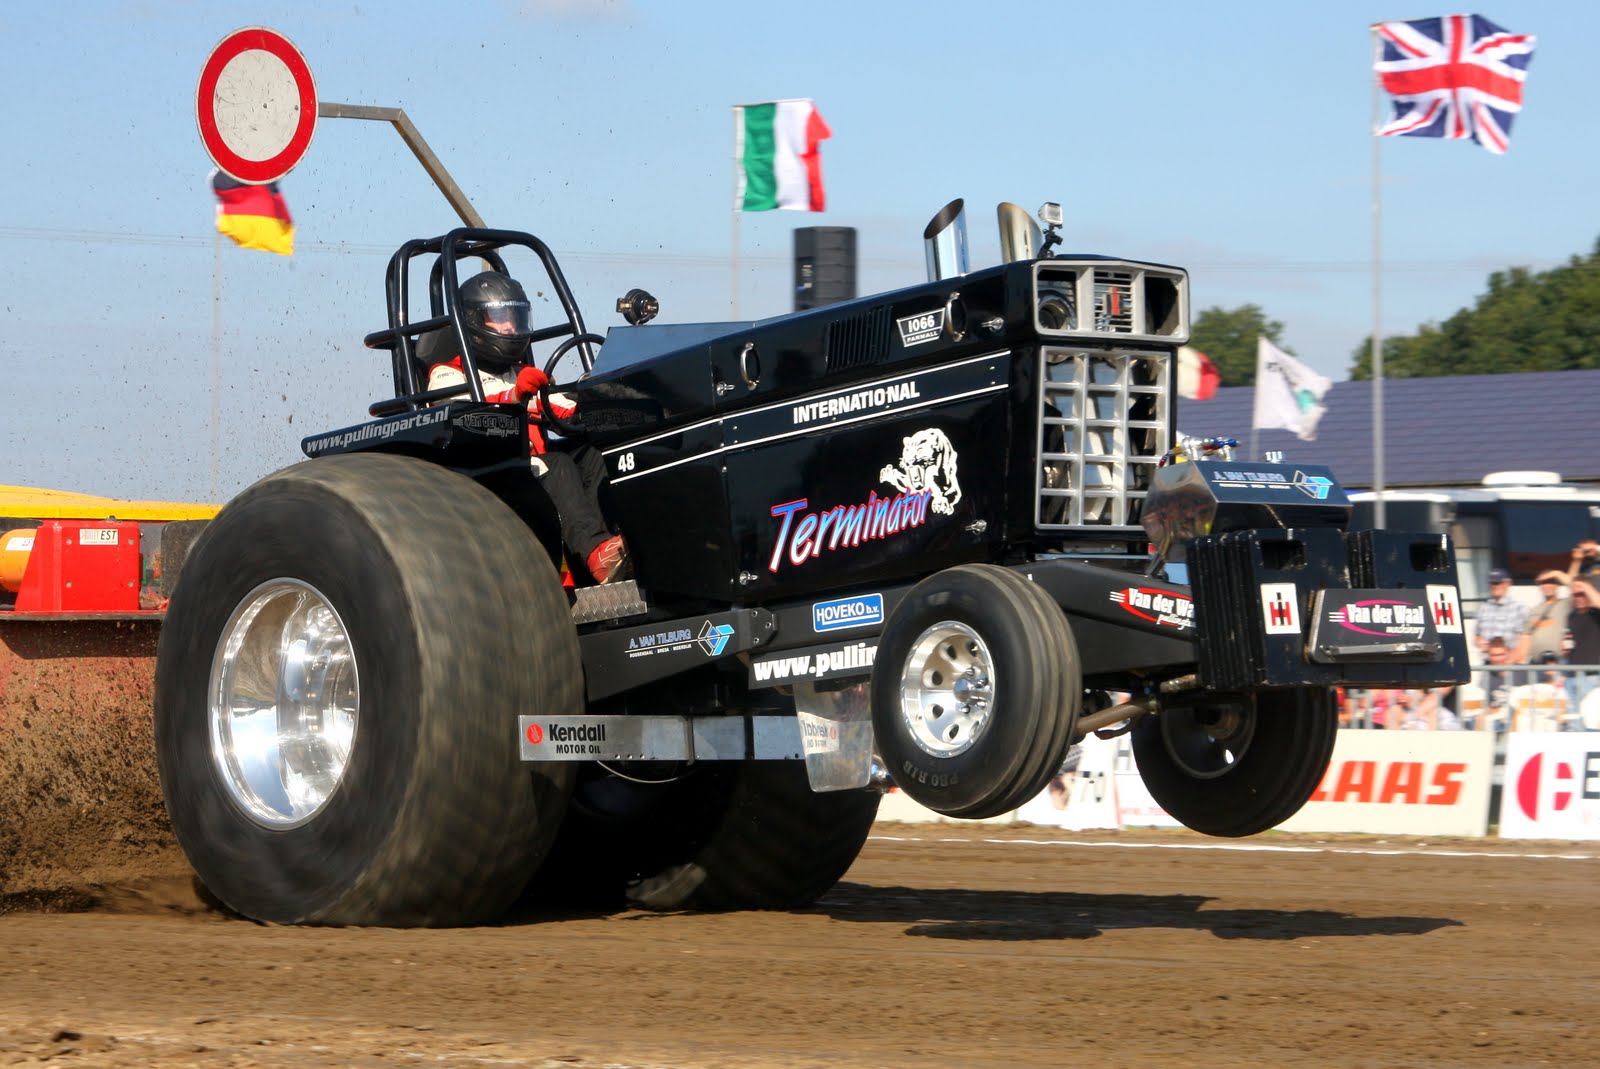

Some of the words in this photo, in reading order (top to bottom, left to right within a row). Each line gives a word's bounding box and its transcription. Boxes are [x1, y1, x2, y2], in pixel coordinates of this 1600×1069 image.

[908, 315, 935, 333] 1066
[906, 331, 938, 342] FARMALL
[793, 381, 920, 424] INTERNATIONAL
[306, 406, 449, 453] www.pullingparts.nl
[464, 414, 481, 427] Van
[482, 415, 497, 427] der
[618, 452, 635, 472] 48
[768, 486, 932, 573] Terminator
[1128, 588, 1151, 609] Van
[1152, 593, 1174, 614] der
[816, 602, 864, 622] HOVEKO
[866, 605, 879, 614] b.v.
[1346, 604, 1371, 623] Van
[1371, 604, 1392, 624] der
[1393, 605, 1424, 625] Waal
[629, 638, 638, 649] A.
[639, 635, 655, 647] VAN
[656, 629, 692, 644] TILBURG
[549, 723, 606, 741] Kendall
[556, 744, 586, 754] MOTOR
[588, 744, 601, 754] OIL
